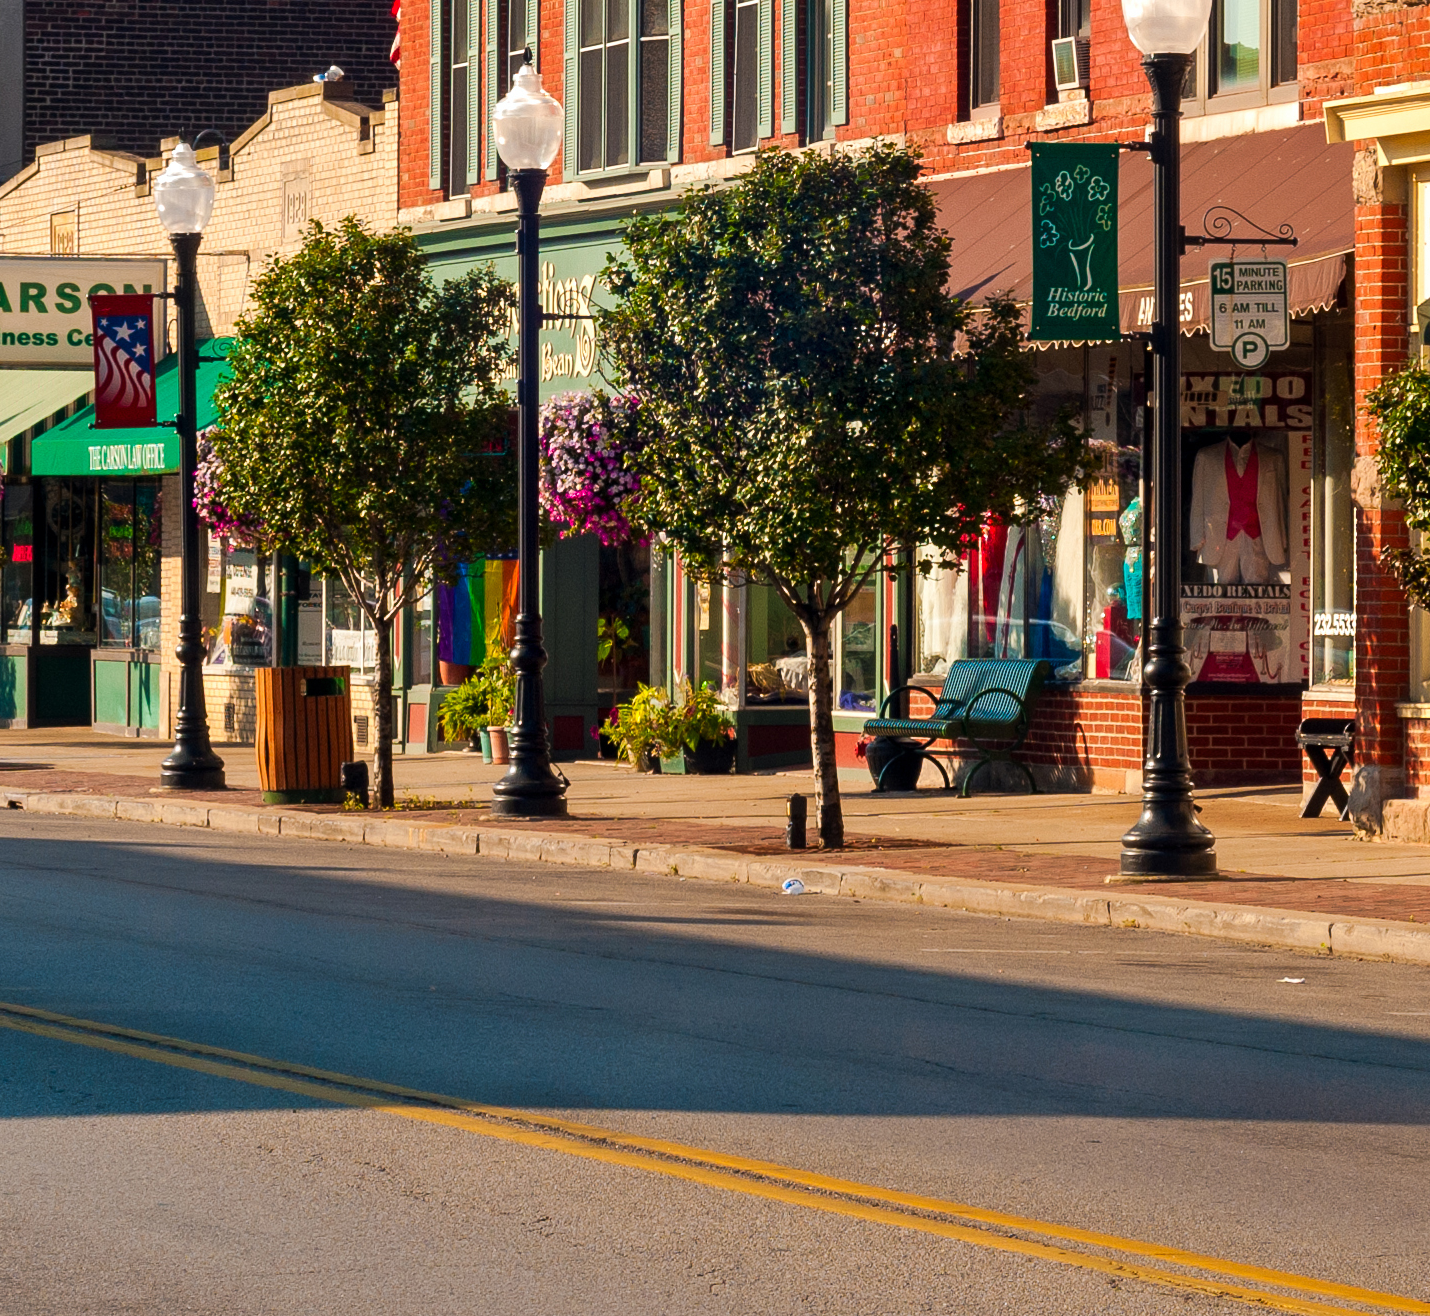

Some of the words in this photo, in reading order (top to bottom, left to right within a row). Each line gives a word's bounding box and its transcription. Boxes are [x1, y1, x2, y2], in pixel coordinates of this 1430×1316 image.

[1213, 267, 1232, 290] 15
[1239, 267, 1280, 277] MINUTE
[1236, 279, 1283, 291] PARKING
[1046, 287, 1107, 302] Historic
[1046, 303, 1108, 321] Bedford
[1219, 303, 1227, 313] 6
[1232, 303, 1250, 313] AM
[1254, 302, 1279, 313] TILL
[1234, 319, 1244, 329] 11
[1248, 319, 1266, 329] AM
[67, 329, 93, 346] Ce
[541, 341, 574, 382] Bean
[1181, 376, 1306, 399] XEDO
[1181, 405, 1313, 427] NTALS
[1182, 585, 1225, 597] XEDO
[1227, 585, 1291, 598] RENTALS
[1183, 601, 1213, 616] Carpet
[1215, 601, 1253, 616] Boutique
[1263, 601, 1291, 614] Bridal
